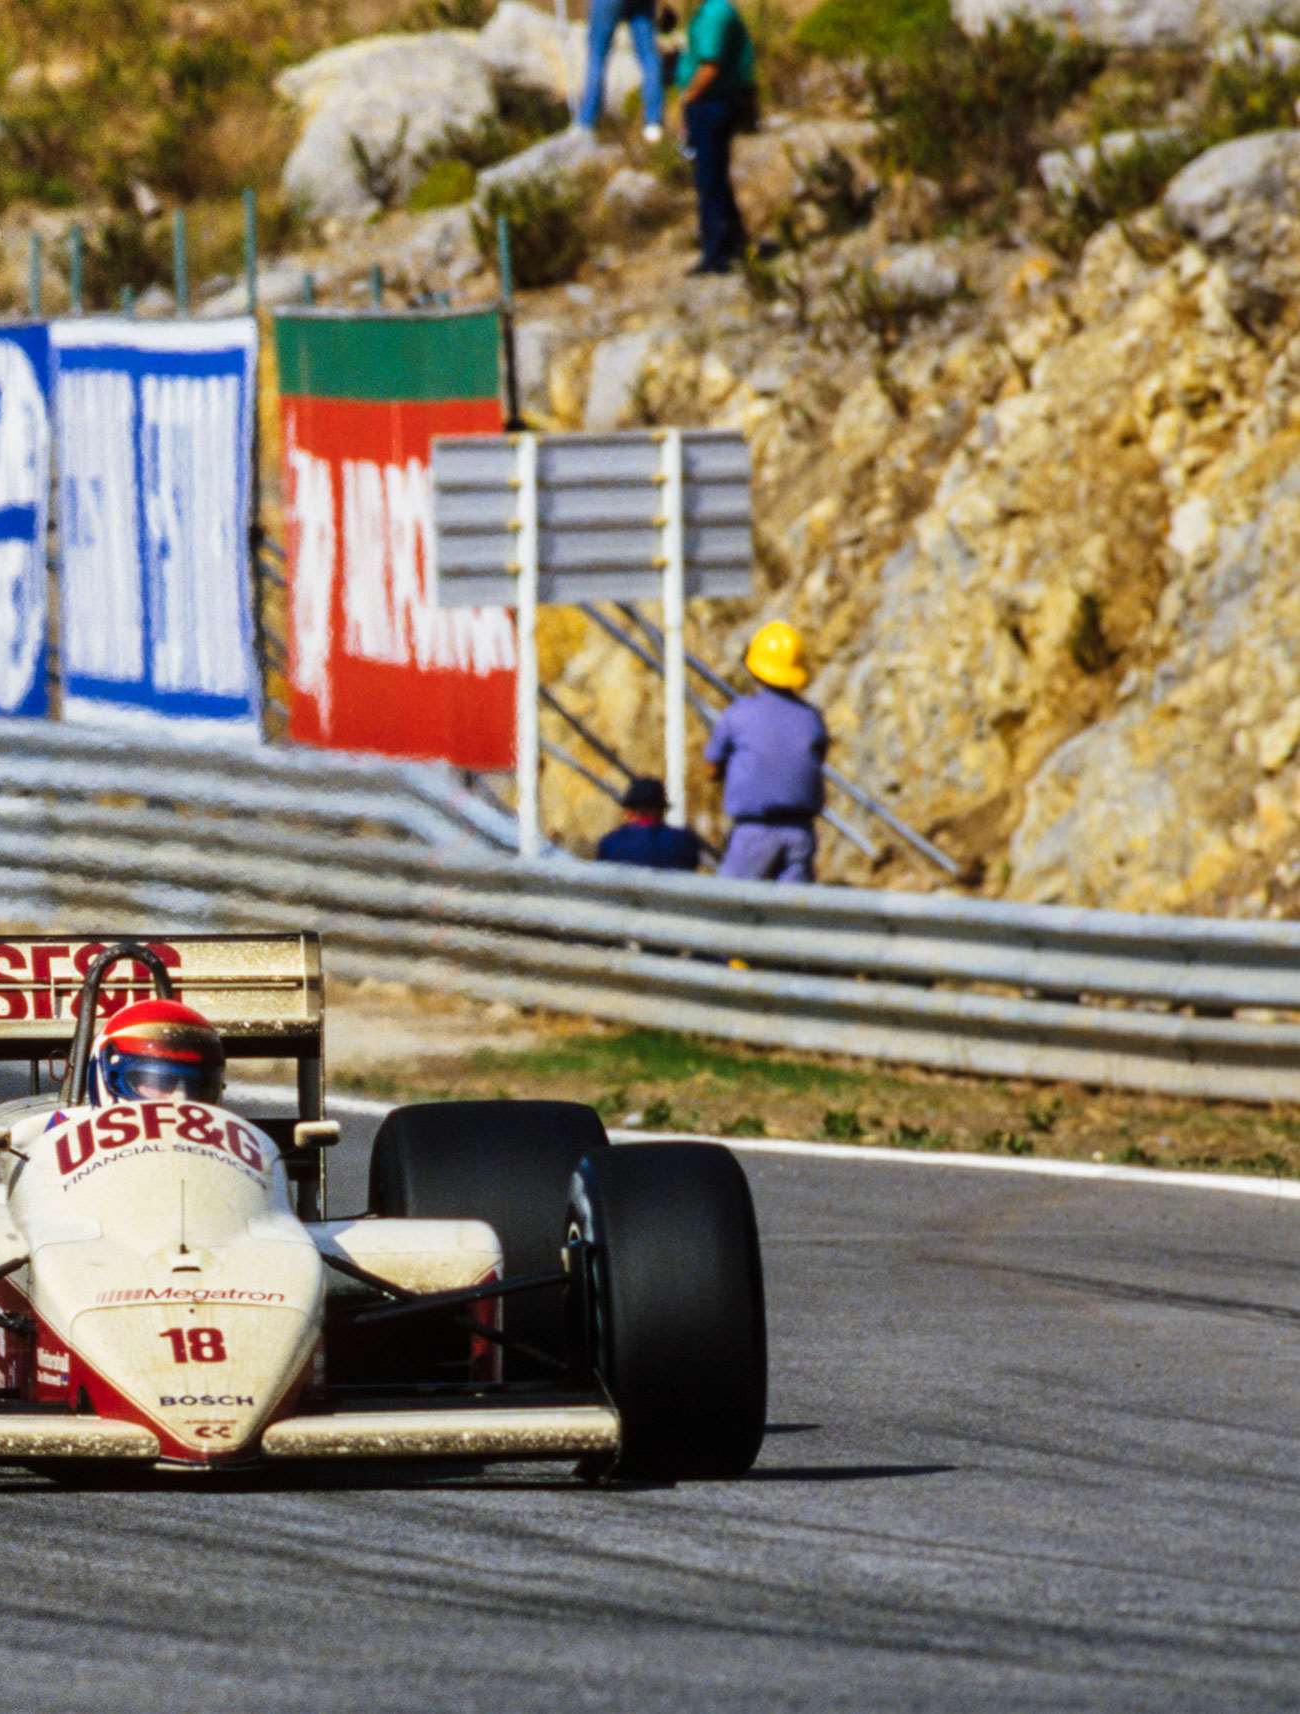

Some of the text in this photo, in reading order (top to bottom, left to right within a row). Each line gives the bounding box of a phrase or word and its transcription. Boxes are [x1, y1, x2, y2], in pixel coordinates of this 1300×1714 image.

[55, 1102, 264, 1176] USF&G
[63, 1143, 164, 1193] FINANCIAL
[145, 1287, 285, 1304] Megatron
[158, 1327, 227, 1364] 18
[159, 1394, 254, 1407] BOSCH
